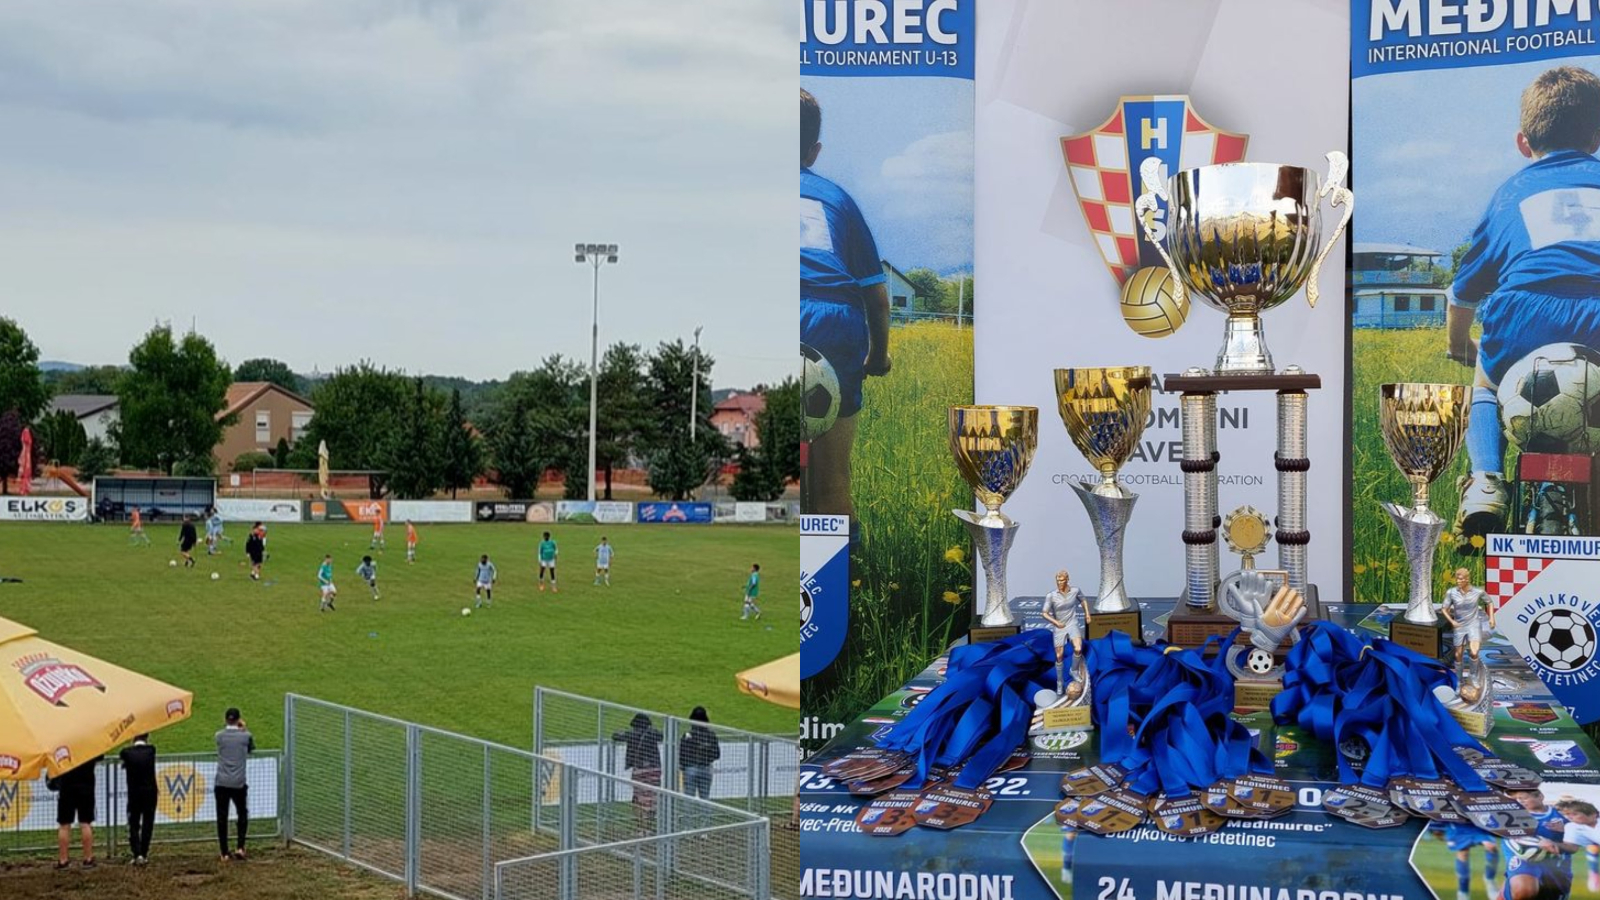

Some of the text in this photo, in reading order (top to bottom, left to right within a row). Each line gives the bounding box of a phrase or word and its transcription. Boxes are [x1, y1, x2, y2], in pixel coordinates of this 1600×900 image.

[800, 0, 957, 44] UREC
[1370, 0, 1600, 41] MEĐIM
[1369, 29, 1595, 63] INTERNATIONAL FOOTBALL
[816, 51, 921, 66] TOURNAMENT
[926, 51, 958, 66] U-13
[1118, 474, 1183, 486] FOOTBALL
[1493, 537, 1514, 553] NK
[831, 804, 859, 814] NK
